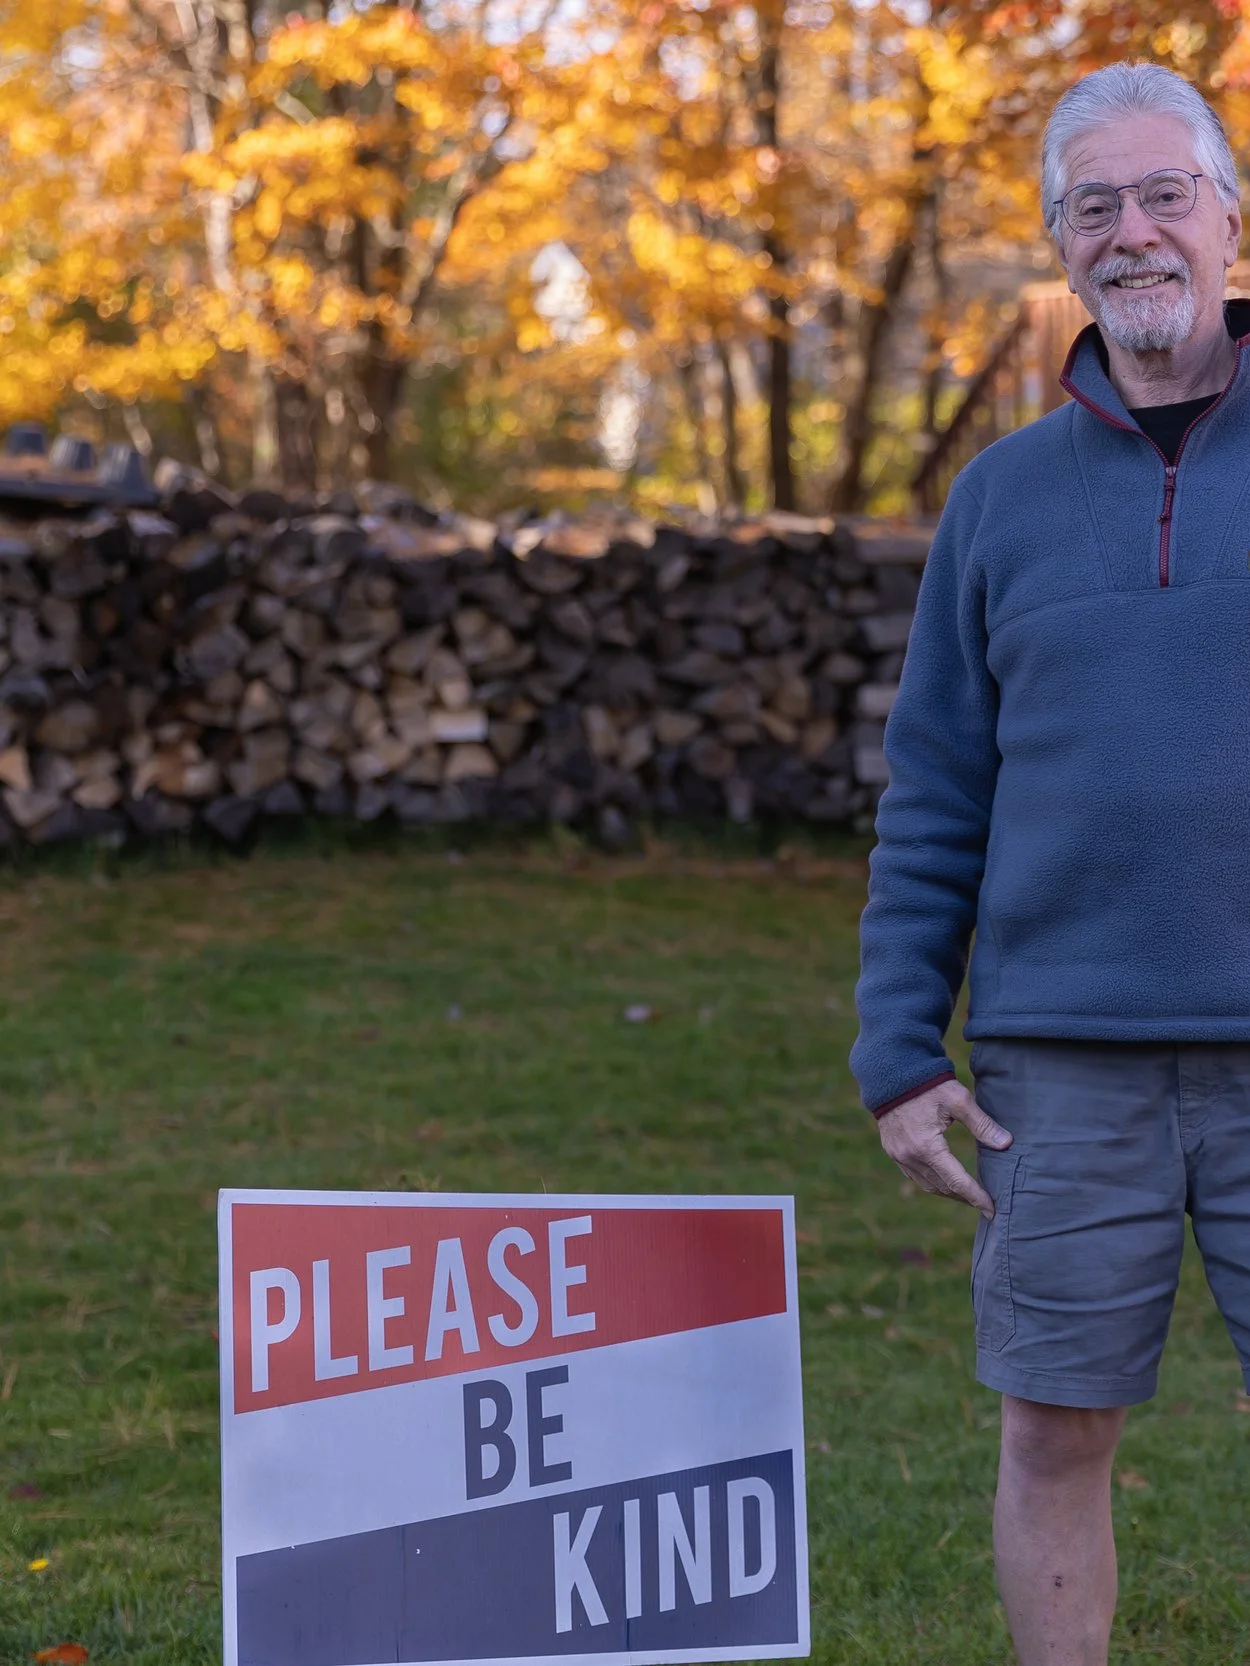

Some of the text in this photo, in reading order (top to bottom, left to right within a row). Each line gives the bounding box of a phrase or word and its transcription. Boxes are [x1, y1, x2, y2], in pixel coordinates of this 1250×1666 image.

[250, 1215, 596, 1393] PLEASE
[463, 1365, 572, 1500] BE
[553, 1477, 777, 1634] KIND
